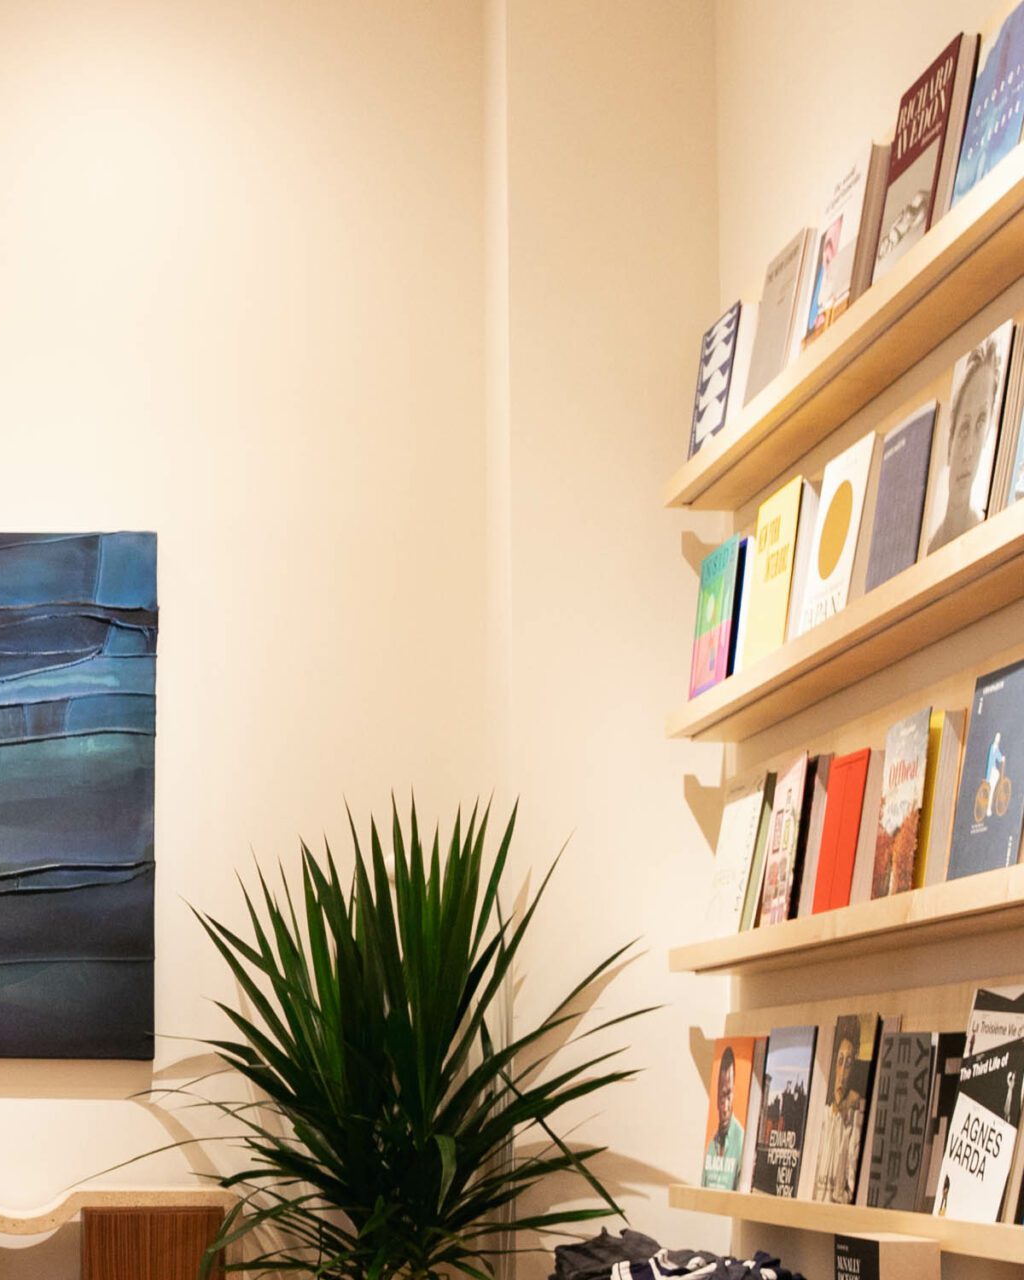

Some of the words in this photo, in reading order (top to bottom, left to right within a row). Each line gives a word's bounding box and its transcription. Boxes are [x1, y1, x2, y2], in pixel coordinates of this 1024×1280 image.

[898, 56, 954, 135] RICHARD
[1008, 1023, 1017, 1037] Vie
[960, 1067, 972, 1082] The
[972, 1059, 989, 1078] Third
[989, 1056, 1001, 1072] Life
[1001, 1051, 1009, 1068] of
[906, 1038, 929, 1178] GRAY
[769, 1130, 796, 1148] EDWARD
[961, 1112, 1003, 1159] AGNÈS
[705, 1155, 724, 1171] BLACK
[949, 1133, 987, 1182] VARDA
[777, 1167, 792, 1184] NEW
[776, 1185, 793, 1198] YORK
